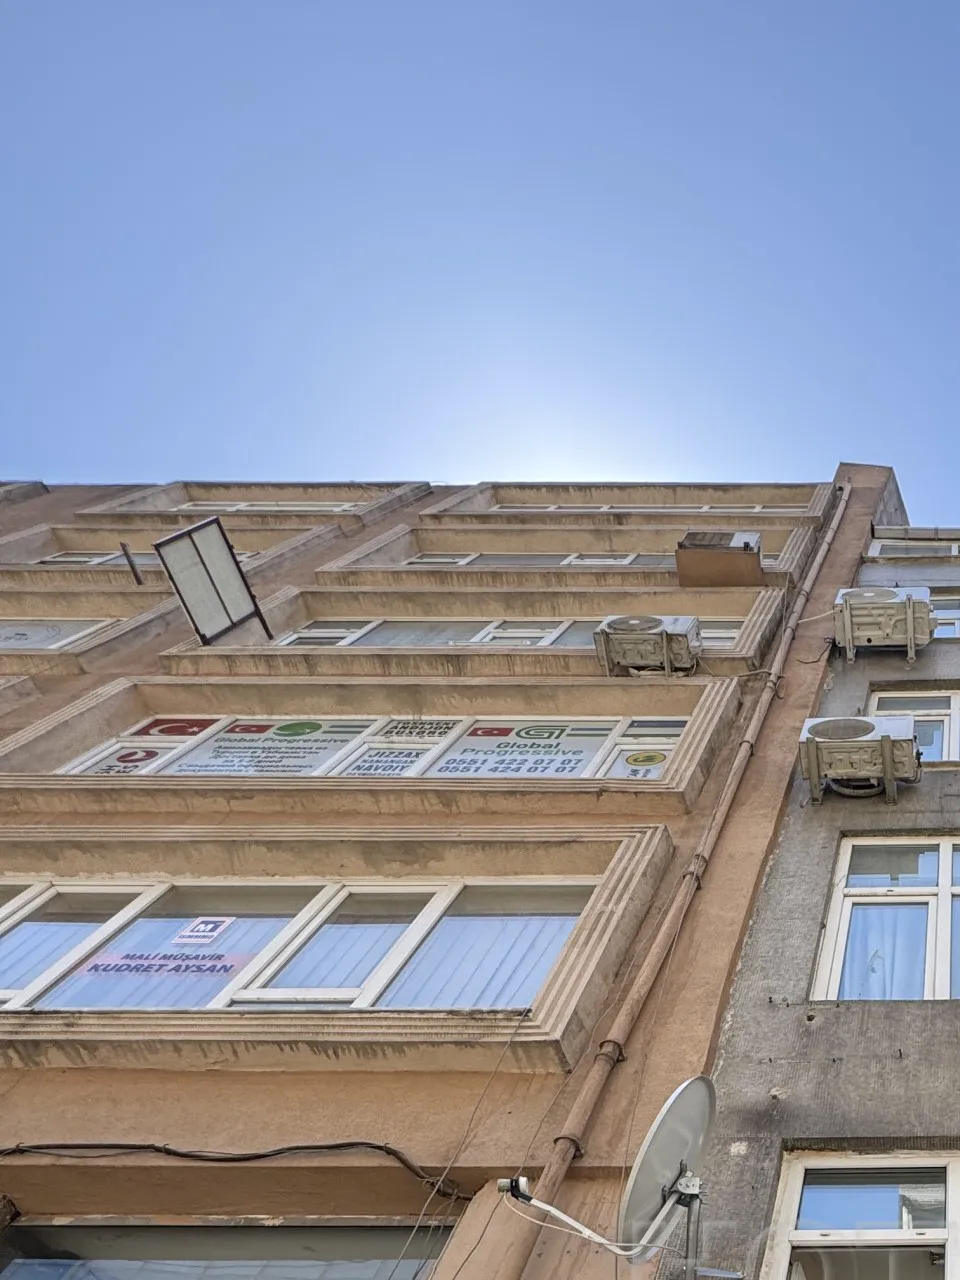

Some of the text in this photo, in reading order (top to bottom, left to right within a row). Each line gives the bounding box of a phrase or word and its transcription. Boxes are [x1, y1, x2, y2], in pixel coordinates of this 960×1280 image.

[495, 741, 561, 749] Global
[368, 751, 425, 759] JIZZAX
[460, 748, 584, 756] Progressive
[444, 758, 585, 766] 0551 422 07 07
[121, 952, 226, 963] MALİ MÜŞAVİR
[87, 963, 235, 973] KUDRET AYSAN
